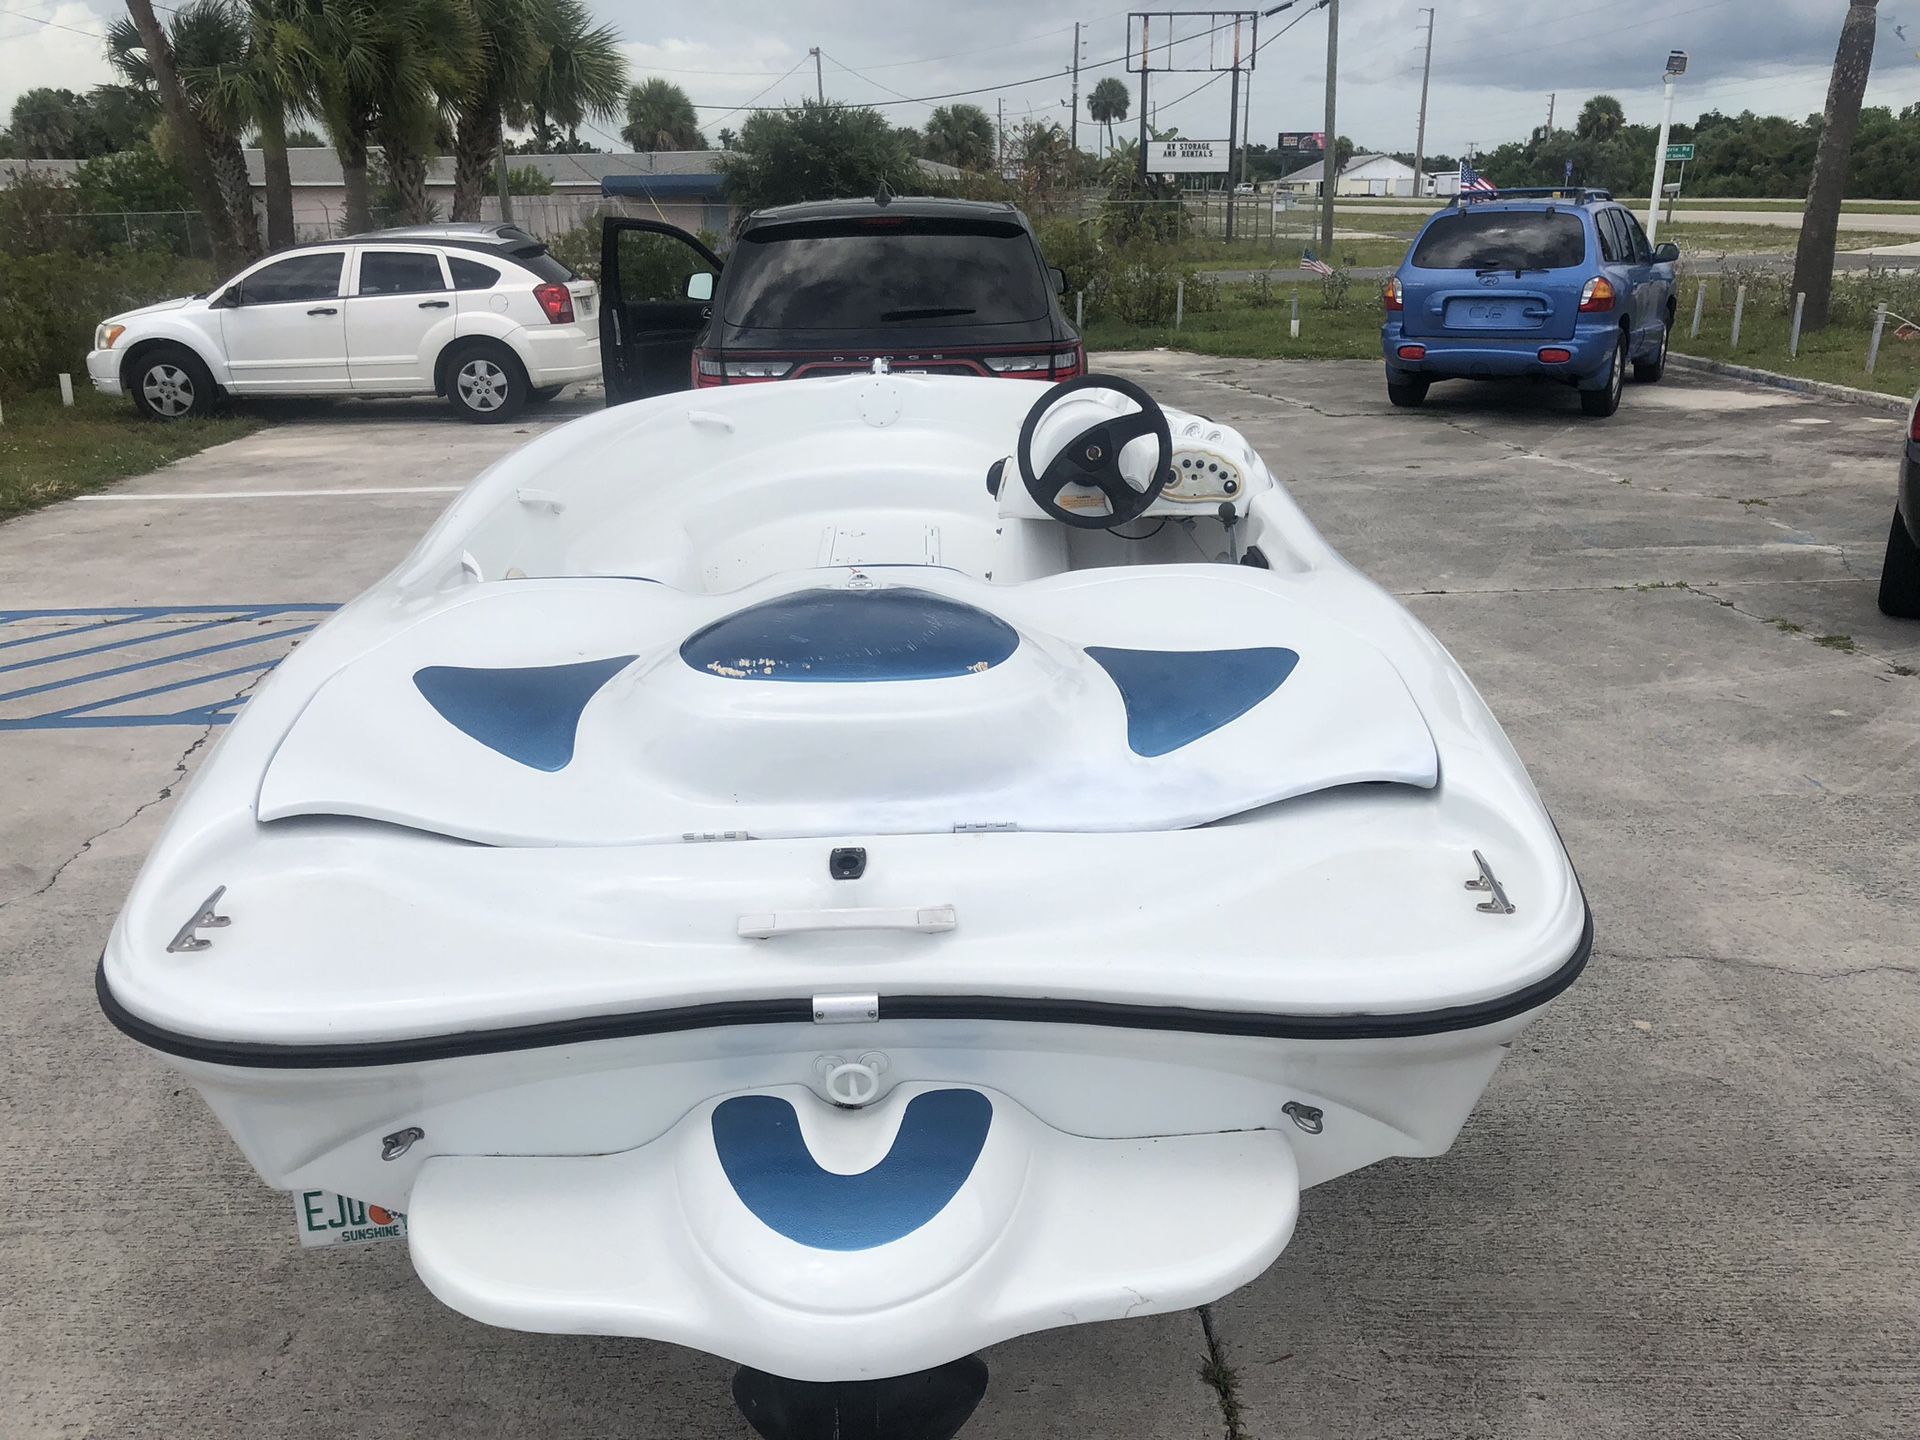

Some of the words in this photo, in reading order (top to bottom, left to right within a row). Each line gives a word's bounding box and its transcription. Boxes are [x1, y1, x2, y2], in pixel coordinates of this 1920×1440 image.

[1166, 143, 1176, 151] RV
[1179, 143, 1210, 151] STORAGE
[1163, 150, 1177, 158] AND
[1181, 150, 1213, 158] RENTALS
[833, 353, 943, 361] DODGE
[341, 1225, 401, 1242] SUNSHINE
